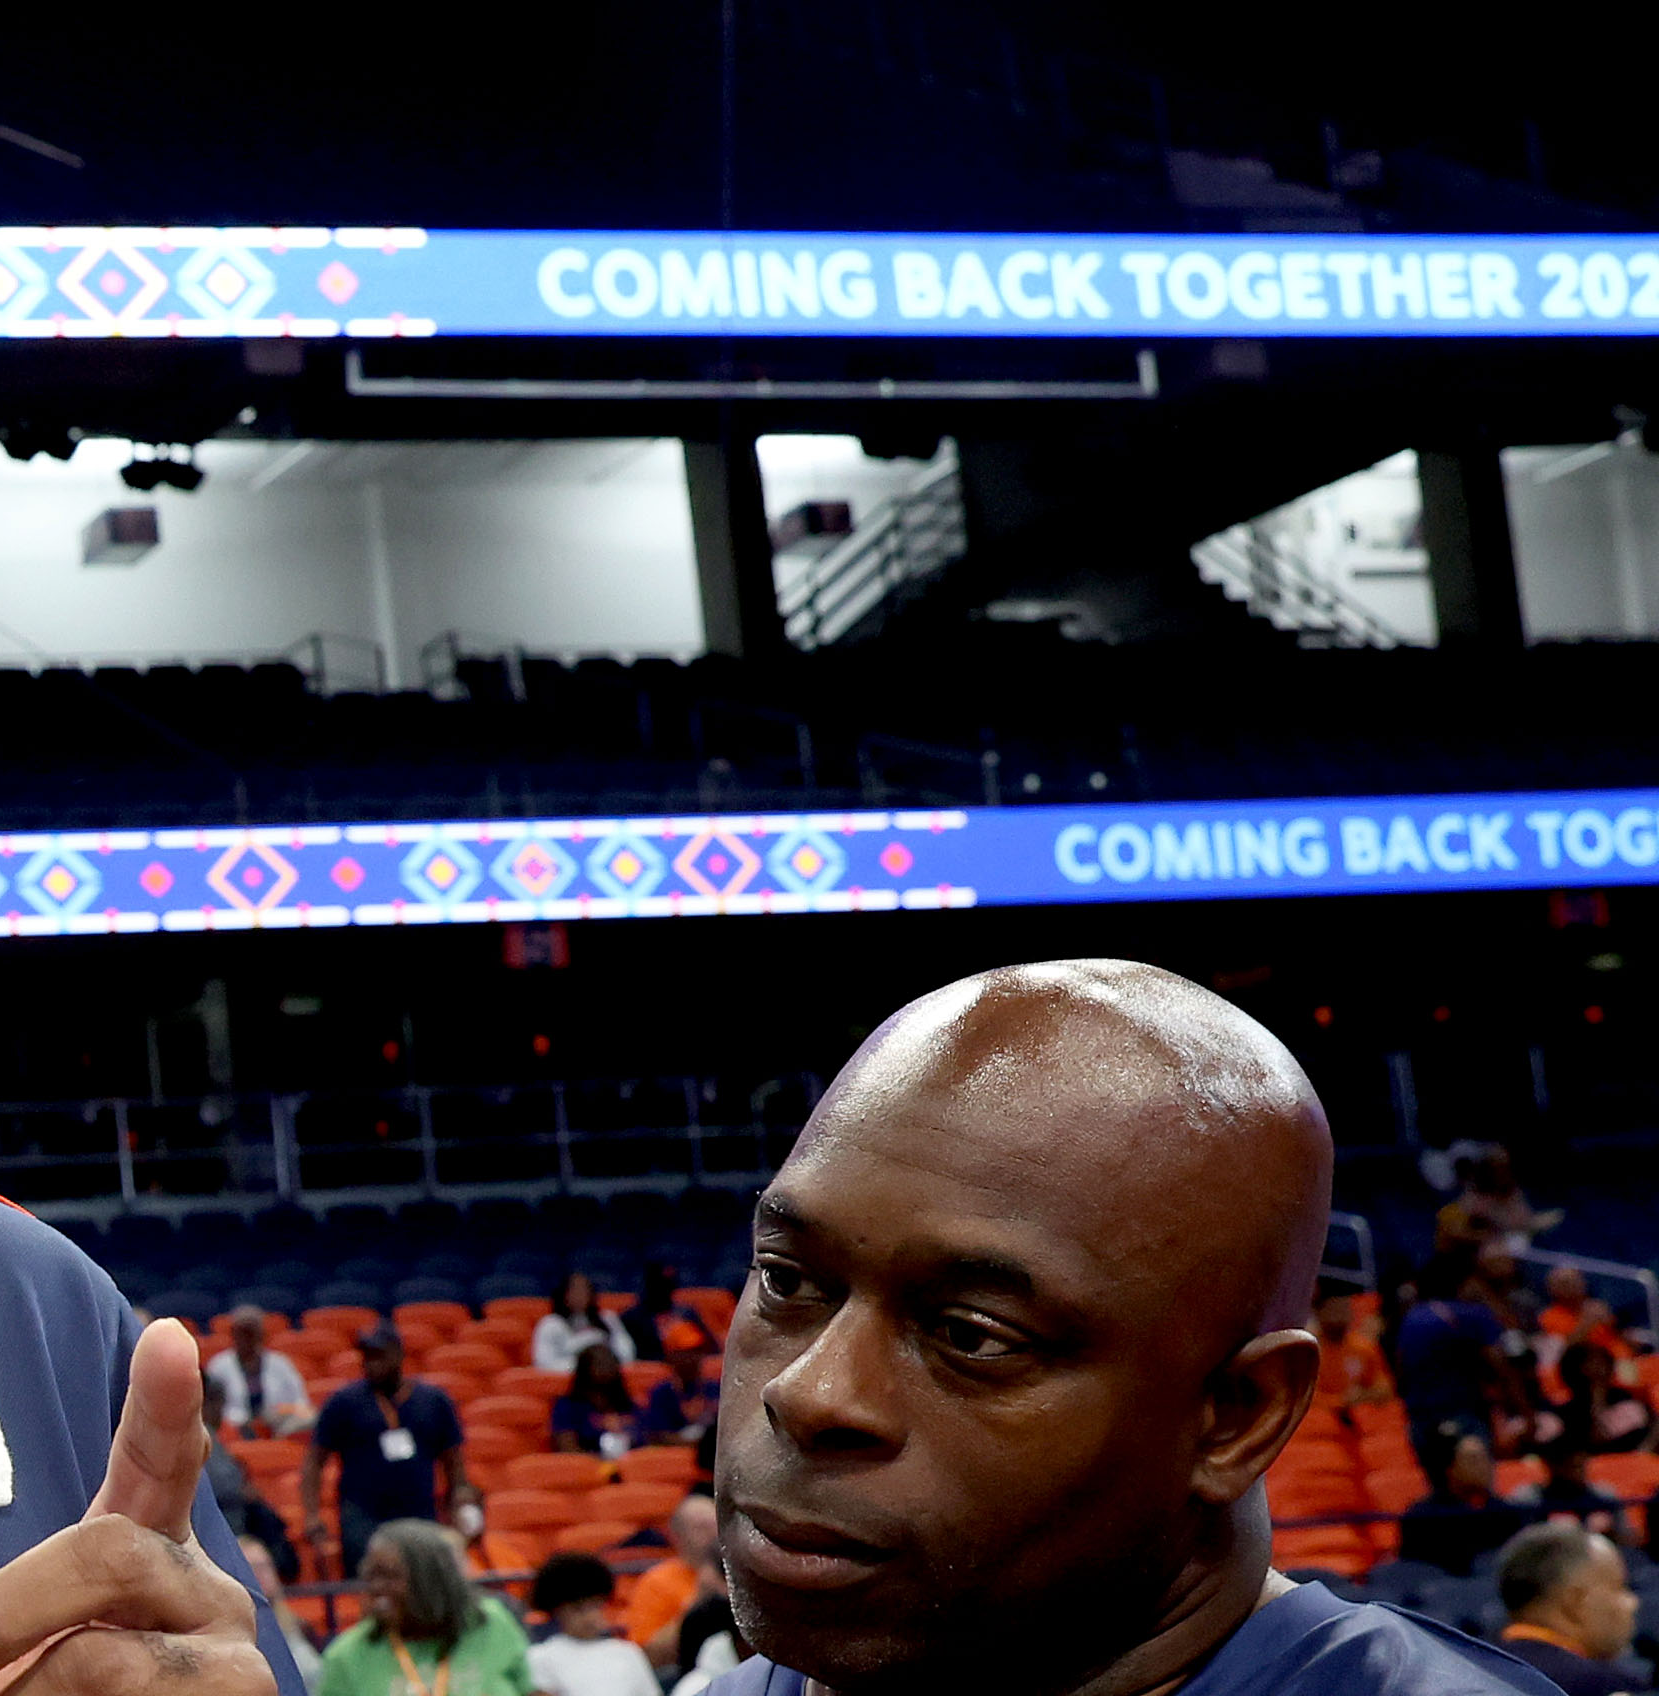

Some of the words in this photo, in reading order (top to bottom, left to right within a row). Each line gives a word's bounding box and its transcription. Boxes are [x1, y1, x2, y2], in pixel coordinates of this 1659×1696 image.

[537, 247, 878, 319] COMING
[893, 250, 1111, 319] BACK
[1120, 250, 1523, 320] TOGETHER
[1537, 251, 1659, 319] 202
[1054, 817, 1330, 884] COMING
[1340, 811, 1519, 875] BACK
